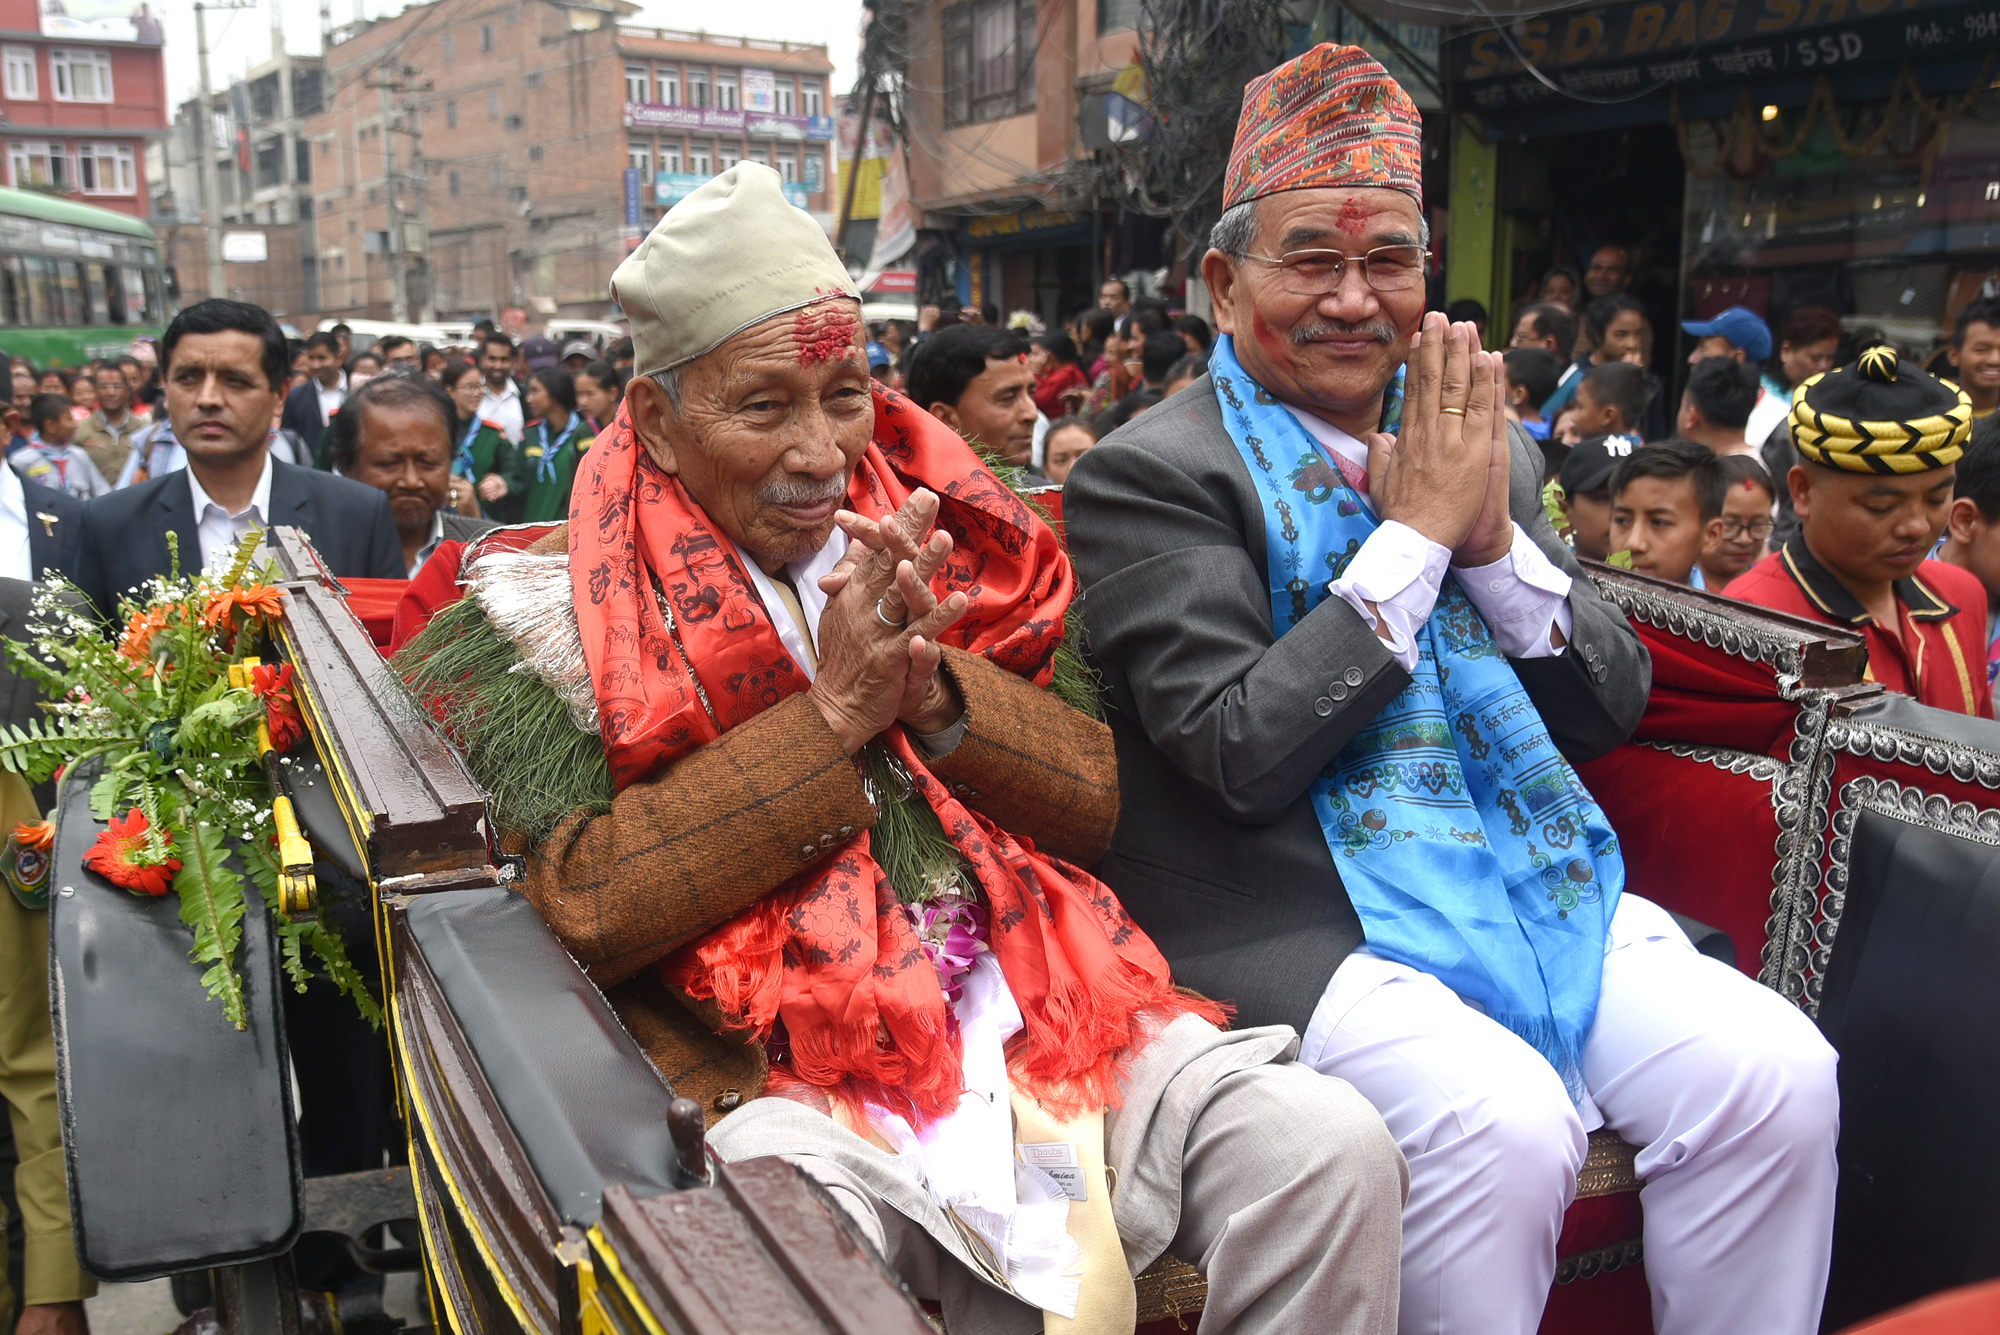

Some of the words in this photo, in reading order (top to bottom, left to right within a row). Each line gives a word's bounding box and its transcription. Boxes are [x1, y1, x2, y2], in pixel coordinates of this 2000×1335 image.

[1622, 0, 1734, 53] BAG
[1964, 12, 2000, 42] 984
[1796, 31, 1864, 67] SSD
[1031, 1147, 1063, 1156] Thoubs
[1048, 1169, 1076, 1180] hmina
